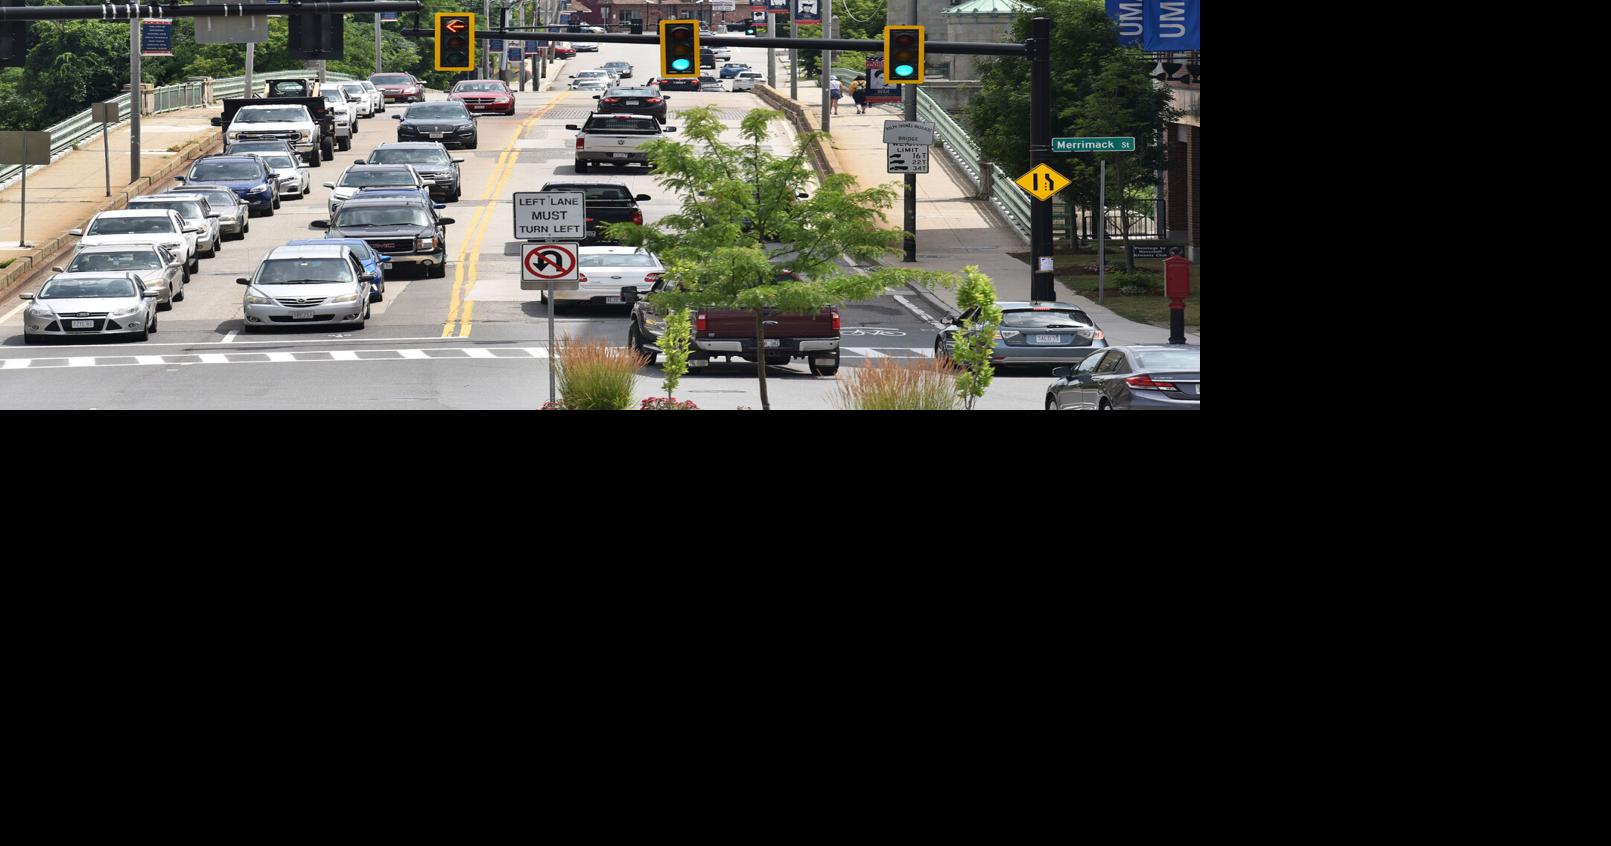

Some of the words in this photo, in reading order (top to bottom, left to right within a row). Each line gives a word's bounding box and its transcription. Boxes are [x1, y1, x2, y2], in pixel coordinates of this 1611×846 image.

[1119, 0, 1143, 36] UM
[1159, 2, 1186, 38] UM
[1057, 140, 1115, 149] Merrimack
[519, 198, 546, 206] LEFT
[550, 197, 579, 206] LANE
[531, 210, 568, 220] MUST
[519, 225, 549, 233] TURN
[553, 225, 581, 233] LEFT
